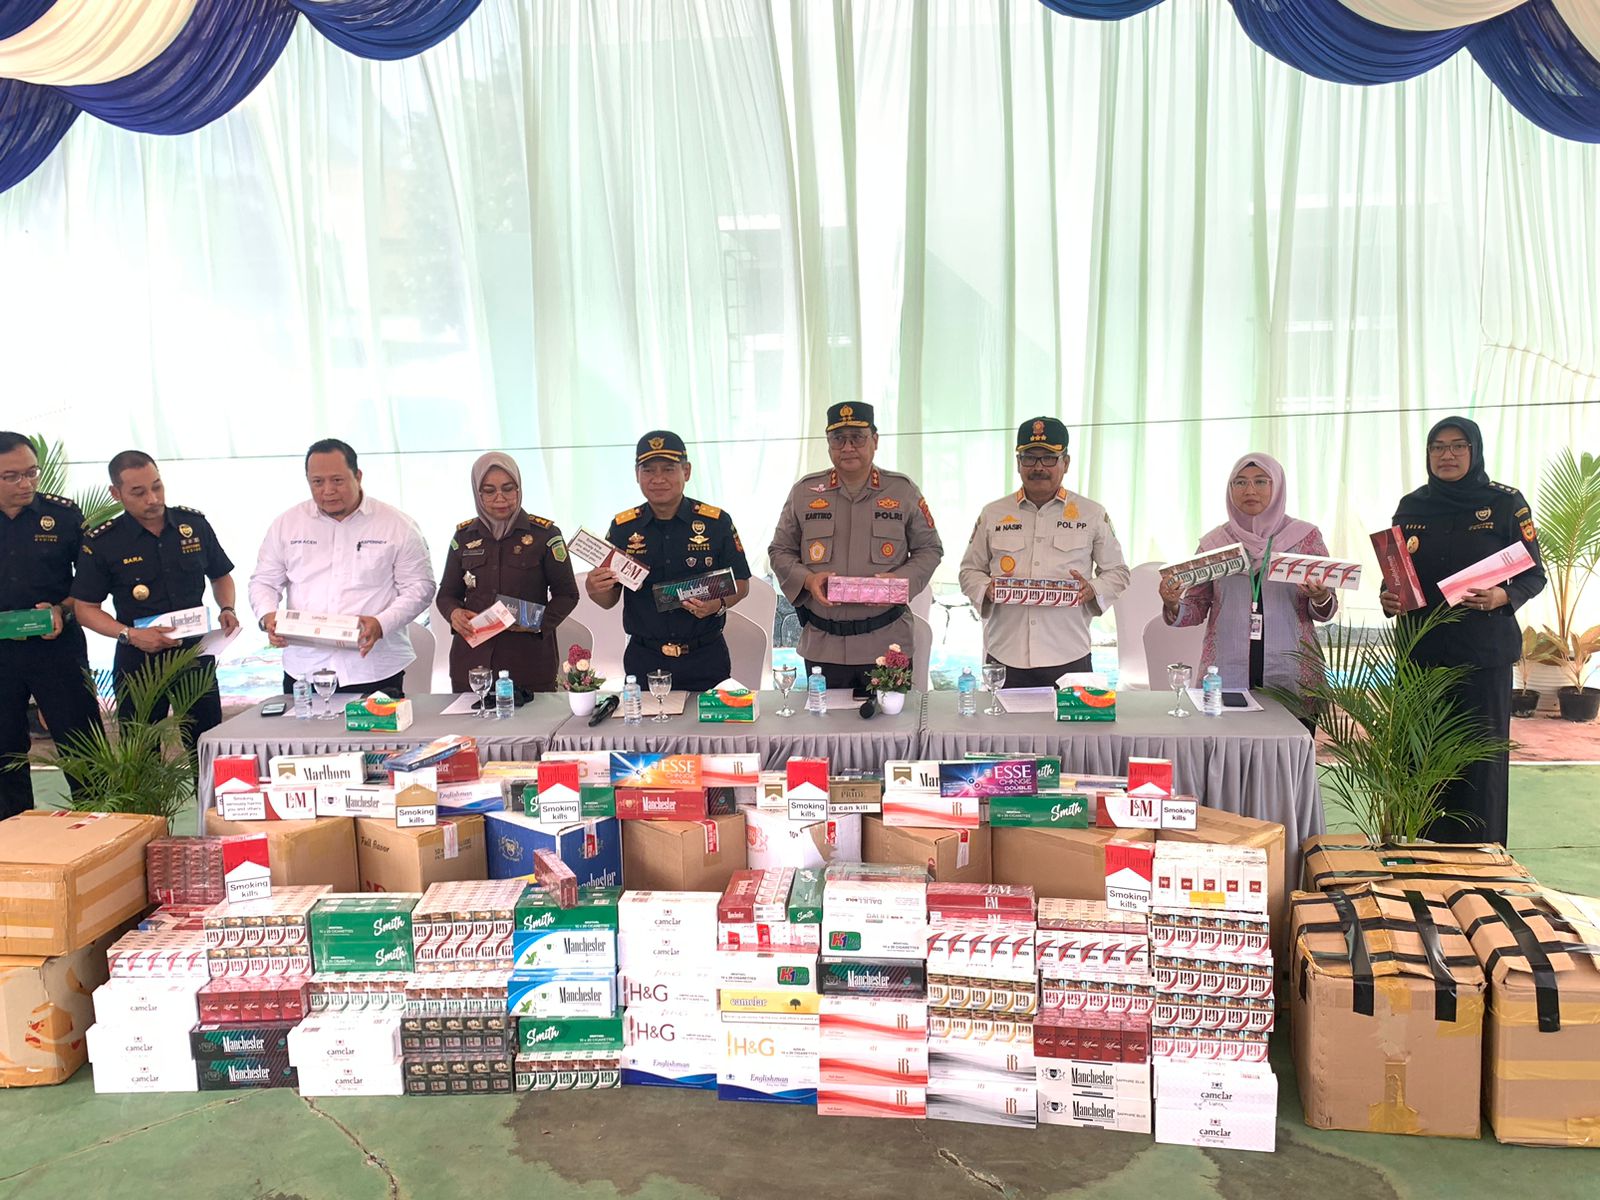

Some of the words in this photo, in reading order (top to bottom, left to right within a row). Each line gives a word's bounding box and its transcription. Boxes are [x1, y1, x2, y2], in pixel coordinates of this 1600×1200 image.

[874, 512, 902, 521] POLRI
[1056, 521, 1074, 529] POL
[1076, 522, 1087, 530] PP
[620, 560, 642, 580] L&M
[304, 765, 350, 781] Marlboro
[661, 760, 696, 772] ESSE
[994, 764, 1032, 779] ESSE
[286, 792, 307, 808] L&M
[345, 795, 380, 809] Manchester
[542, 804, 576, 812] Smoking
[642, 796, 677, 811] Manchester
[791, 802, 825, 811] Smoking
[399, 808, 434, 818] Smoking
[1050, 802, 1083, 822] Smith
[1130, 800, 1152, 817] L&M
[1164, 806, 1195, 815] Smoking
[230, 881, 268, 892] Smoking
[241, 890, 258, 898] kills
[1110, 890, 1148, 903] Smoking
[1120, 900, 1137, 909] kills
[373, 915, 405, 936] Smith
[523, 912, 556, 930] Smith
[564, 937, 606, 954] Manchester
[375, 946, 406, 966] Smith
[847, 970, 889, 988] Manchester
[560, 986, 602, 1004] Manchester
[630, 982, 668, 1002] H&G
[526, 1026, 560, 1046] Smith
[637, 1022, 675, 1042] H&G
[222, 1034, 265, 1053] Manchester
[734, 1037, 774, 1056] H&G
[228, 1065, 270, 1082] Manchester
[750, 1074, 789, 1084] Englishman
[1071, 1067, 1114, 1085] Manchester
[1200, 1091, 1232, 1100] camclar
[1072, 1100, 1115, 1118] Manchester
[1199, 1128, 1231, 1137] camclar
